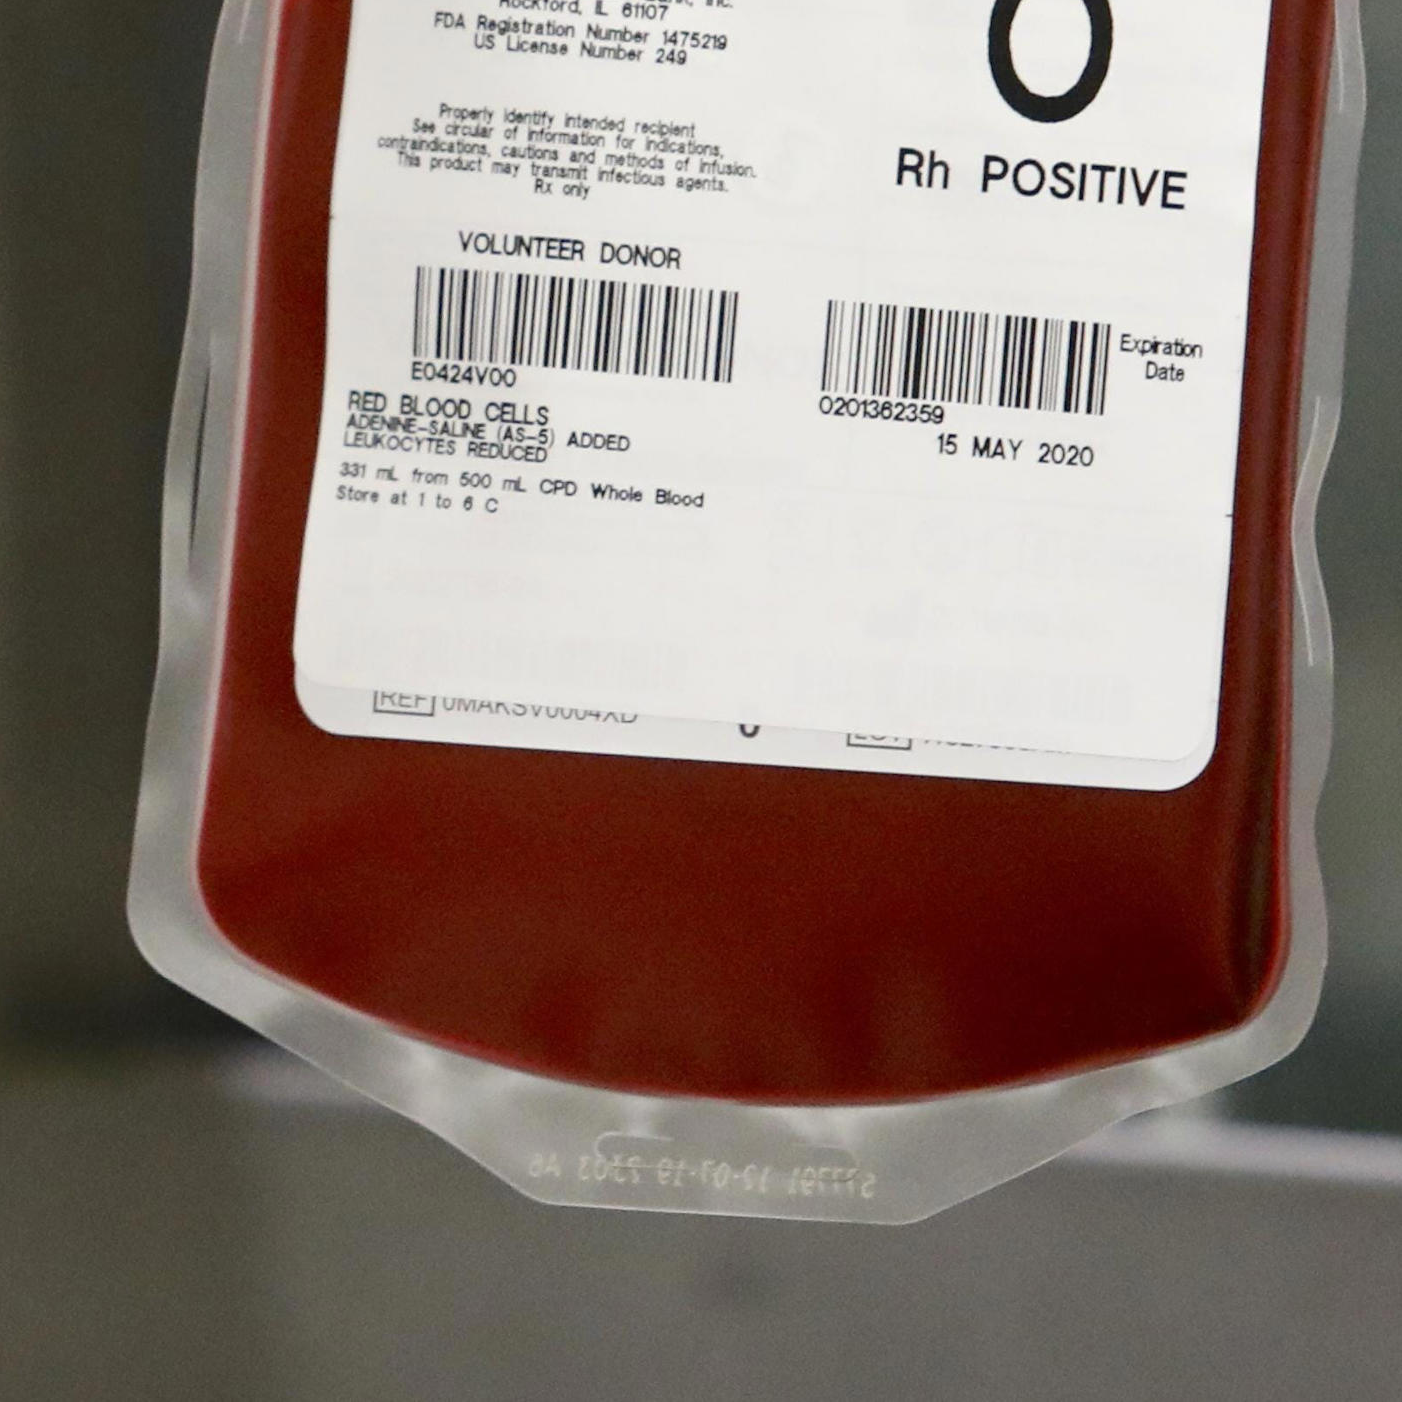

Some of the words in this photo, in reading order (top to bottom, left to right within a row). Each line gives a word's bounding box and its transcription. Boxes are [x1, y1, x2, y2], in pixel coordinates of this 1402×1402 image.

[594, 0, 608, 16] IL
[622, 2, 669, 20] 61107
[434, 11, 466, 29] FDA
[476, 14, 575, 37] Registration
[586, 23, 649, 44] Number
[662, 31, 728, 51] 1475219
[474, 33, 496, 50] US
[506, 35, 568, 55] License
[580, 40, 644, 61] Number
[655, 48, 688, 65] 249
[412, 118, 436, 135] See
[445, 121, 494, 139] circular
[504, 125, 519, 141] of
[527, 126, 605, 147] information
[616, 133, 635, 148] for
[439, 102, 494, 124] Properly
[564, 113, 626, 133] intended
[634, 119, 696, 139] recipient
[397, 150, 421, 168] This
[429, 155, 483, 173] product
[491, 161, 520, 178] may
[530, 161, 588, 181] transmit
[597, 166, 666, 187] infectious
[676, 174, 729, 193] agents.
[500, 144, 559, 162] cautions
[569, 149, 596, 165] and
[605, 151, 665, 170] methods
[675, 157, 690, 172] of
[534, 178, 553, 195] Rx
[562, 181, 591, 201] only
[896, 147, 950, 190] Rh
[981, 155, 1188, 210] POSITIVE
[458, 230, 586, 263] VOLUNTEER
[599, 242, 682, 270] DONOR
[1119, 333, 1203, 359] Expiration
[410, 361, 517, 388] E0424V00
[1145, 361, 1185, 383] Date
[348, 390, 387, 413] RED
[399, 394, 472, 420] BLOOD
[485, 402, 550, 426] CELLS
[818, 394, 945, 425] 0201362359
[344, 430, 457, 456] LEUKOCYTES
[467, 440, 548, 463] REDUCED
[346, 413, 486, 440] ADENINE-SALINE
[498, 424, 555, 448] (AS-5)
[567, 431, 632, 452] ADDED
[937, 432, 959, 456] 15
[971, 435, 1024, 461] MAY
[1036, 442, 1096, 467] 2020
[336, 484, 380, 504] Store
[390, 490, 407, 506] at
[436, 493, 452, 510] to
[463, 495, 474, 512] 6
[484, 497, 499, 514] C
[339, 461, 367, 479] 331
[375, 465, 399, 482] mL
[411, 467, 448, 486] from
[459, 471, 493, 489] 500
[502, 475, 527, 493] mL
[539, 479, 578, 497] CPD
[590, 483, 643, 503] Whole
[655, 489, 705, 508] Blood
